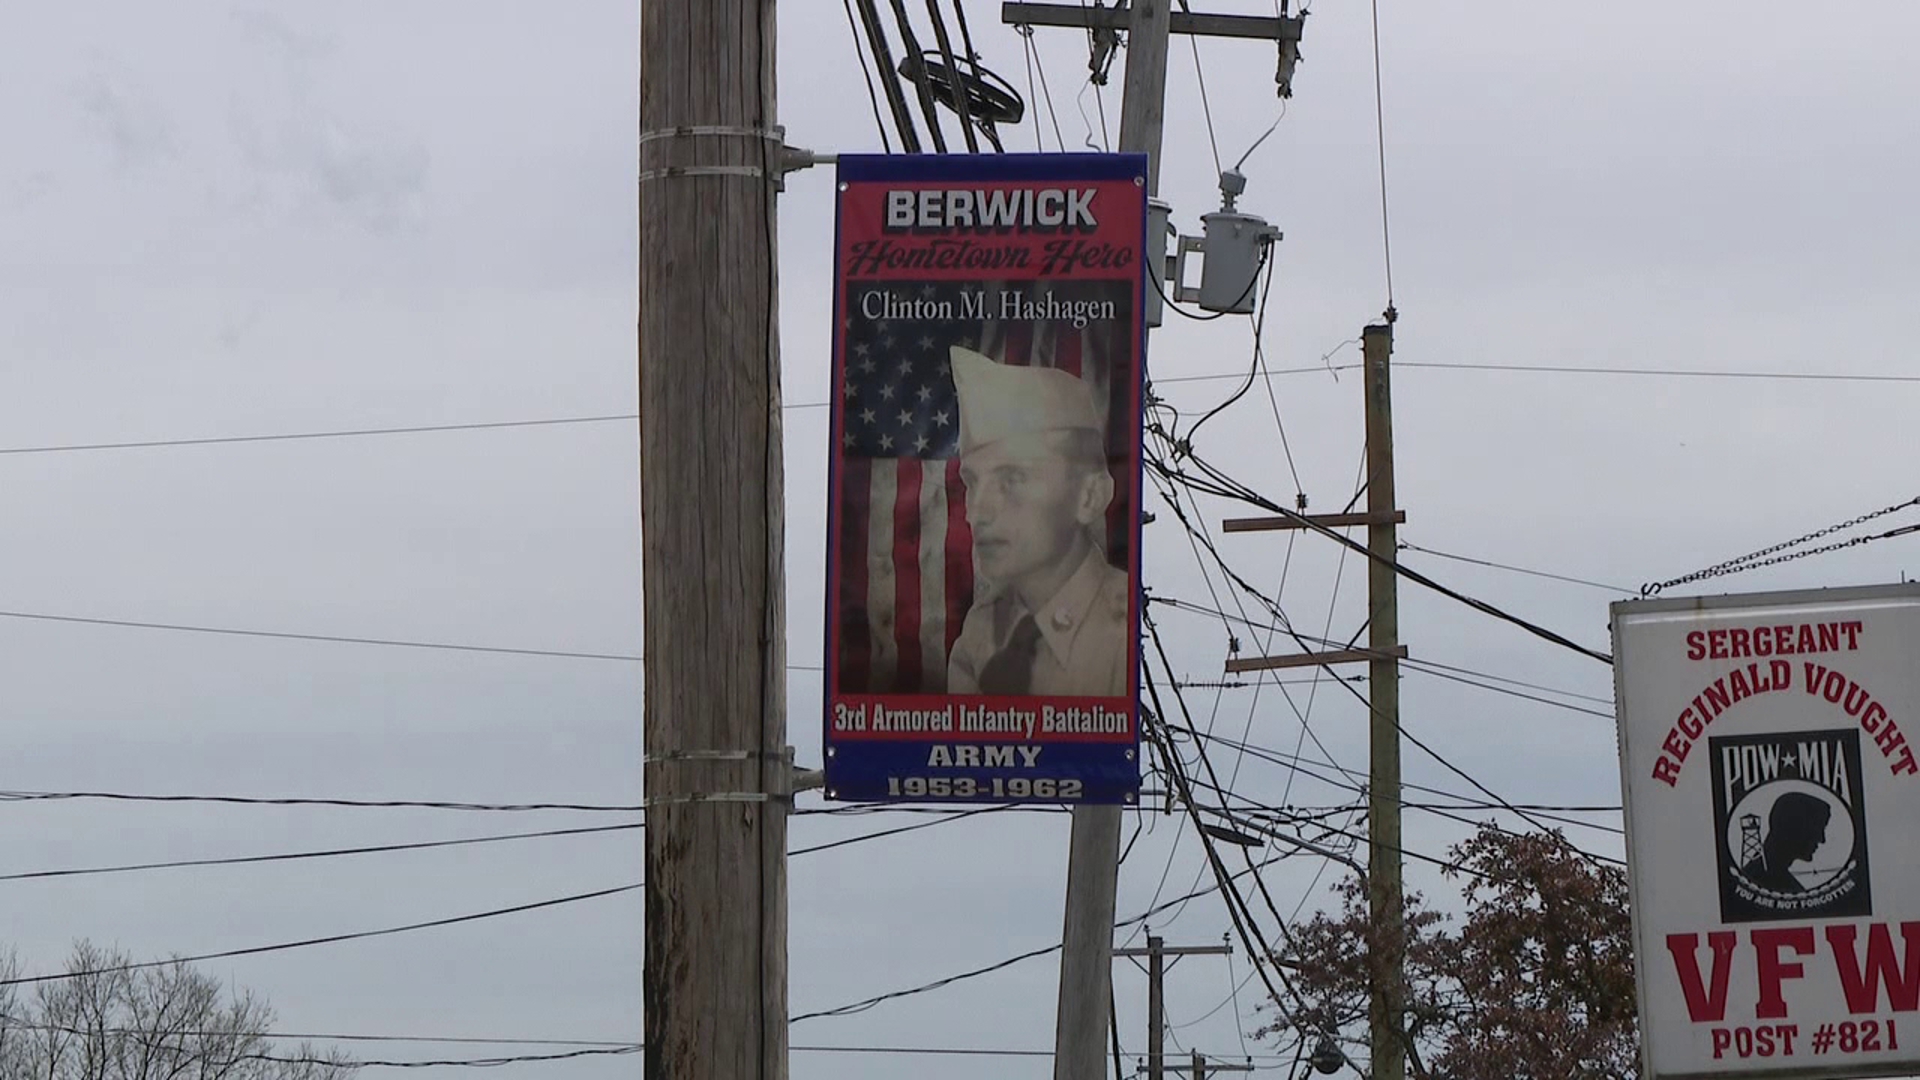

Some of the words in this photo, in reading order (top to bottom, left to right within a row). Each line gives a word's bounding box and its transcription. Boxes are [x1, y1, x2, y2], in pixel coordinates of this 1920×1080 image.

[885, 188, 1098, 231] BERWICK
[847, 239, 1032, 276] Hometown
[1039, 239, 1133, 275] Hero
[861, 290, 953, 320] Clinton
[959, 291, 992, 320] M.
[1000, 290, 1116, 329] Hashagen
[1686, 620, 1863, 661] SERGEANT
[834, 703, 866, 732] 3rd
[872, 704, 953, 733] Armored
[959, 704, 1036, 739] Infantry
[1042, 705, 1129, 734] Battalion
[1652, 659, 1791, 788] REGINALD
[1804, 662, 1919, 777] VOUGHT
[927, 744, 1043, 768] ARMY
[887, 776, 1083, 799] 1953-1962
[1722, 743, 1781, 814] POW
[1797, 739, 1852, 807] MIA
[1734, 884, 1754, 901] YOU
[1754, 896, 1774, 909] ARE
[1776, 900, 1798, 909] NOT
[1801, 879, 1856, 909] FORGOTTEN
[1666, 920, 1920, 1023] VFW
[1711, 1024, 1799, 1059] POST
[1811, 1019, 1899, 1056] #821
